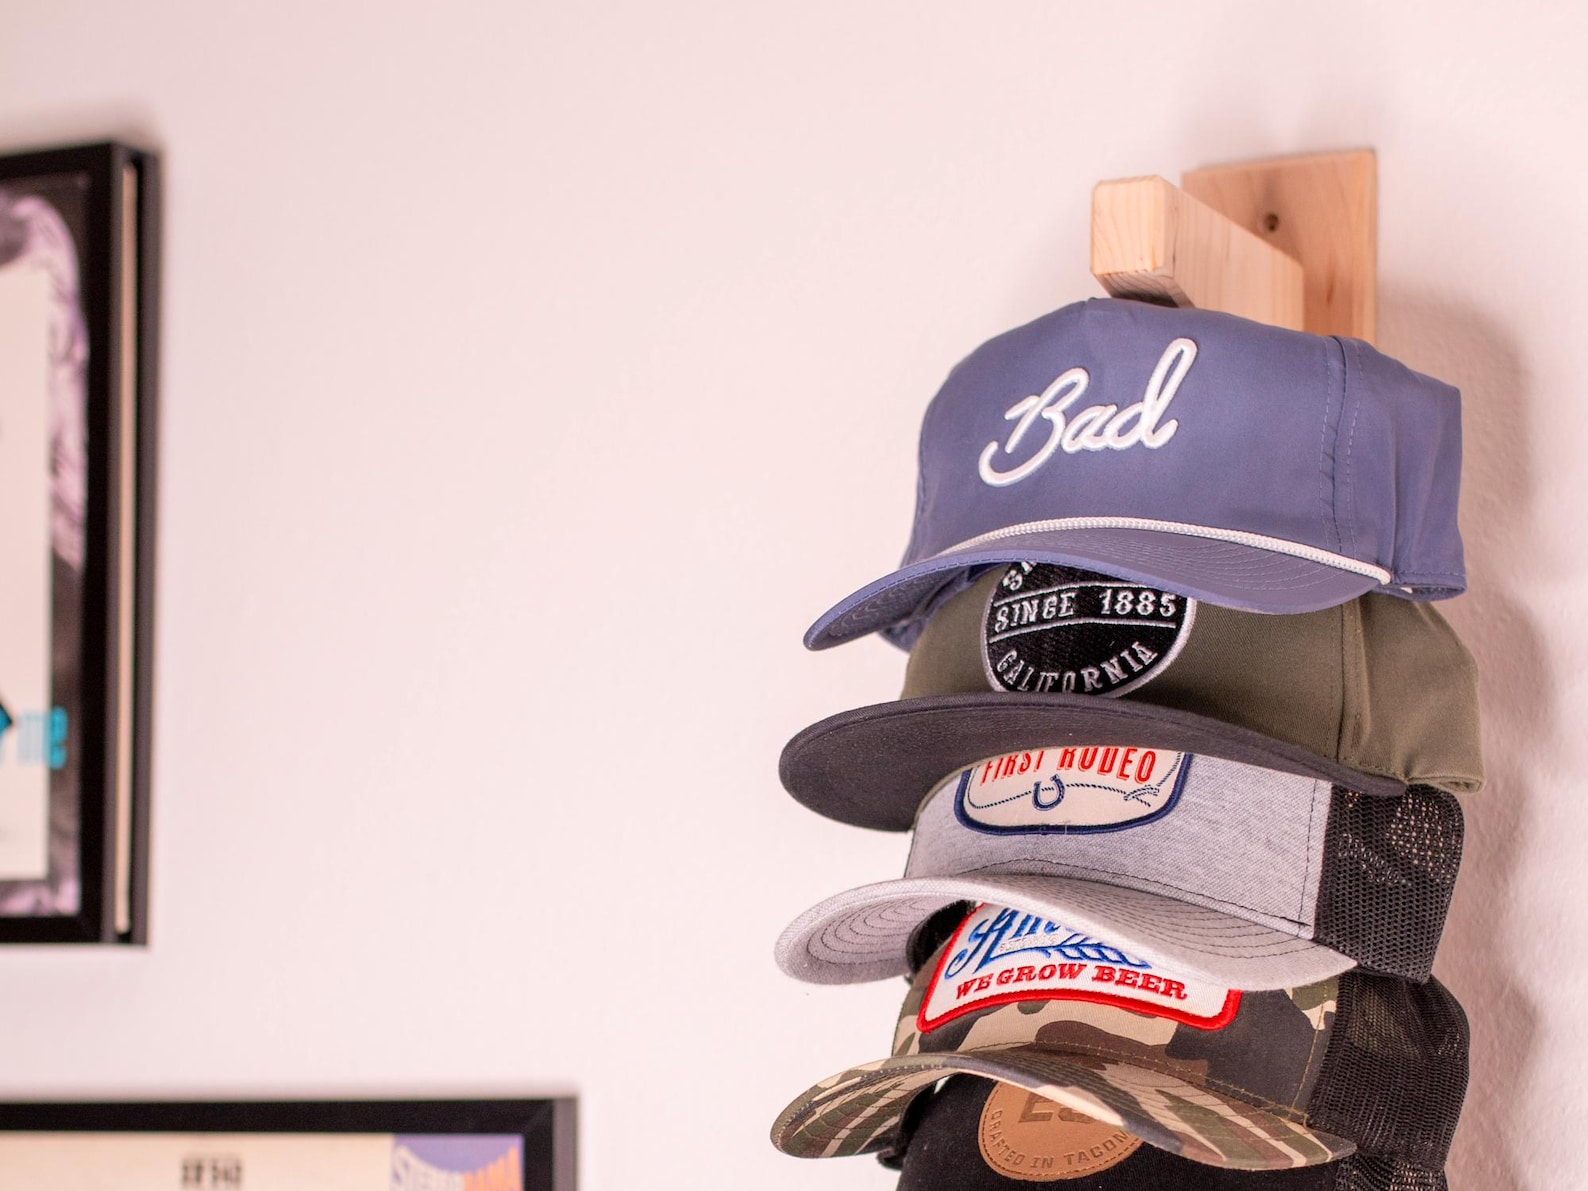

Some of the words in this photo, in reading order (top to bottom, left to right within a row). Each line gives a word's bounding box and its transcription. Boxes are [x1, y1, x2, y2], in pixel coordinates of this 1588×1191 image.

[979, 337, 1198, 487] Bad
[994, 592, 1077, 633] SINCE
[1099, 588, 1177, 618] 1885
[996, 641, 1158, 693] CALIFORNIA
[1057, 746, 1156, 784] RODEO
[956, 973, 994, 1000] WE
[996, 963, 1087, 985] GROW
[1091, 965, 1188, 1000] BEER
[990, 1110, 1025, 1166] CRAFTED
[1030, 1156, 1054, 1169] IN
